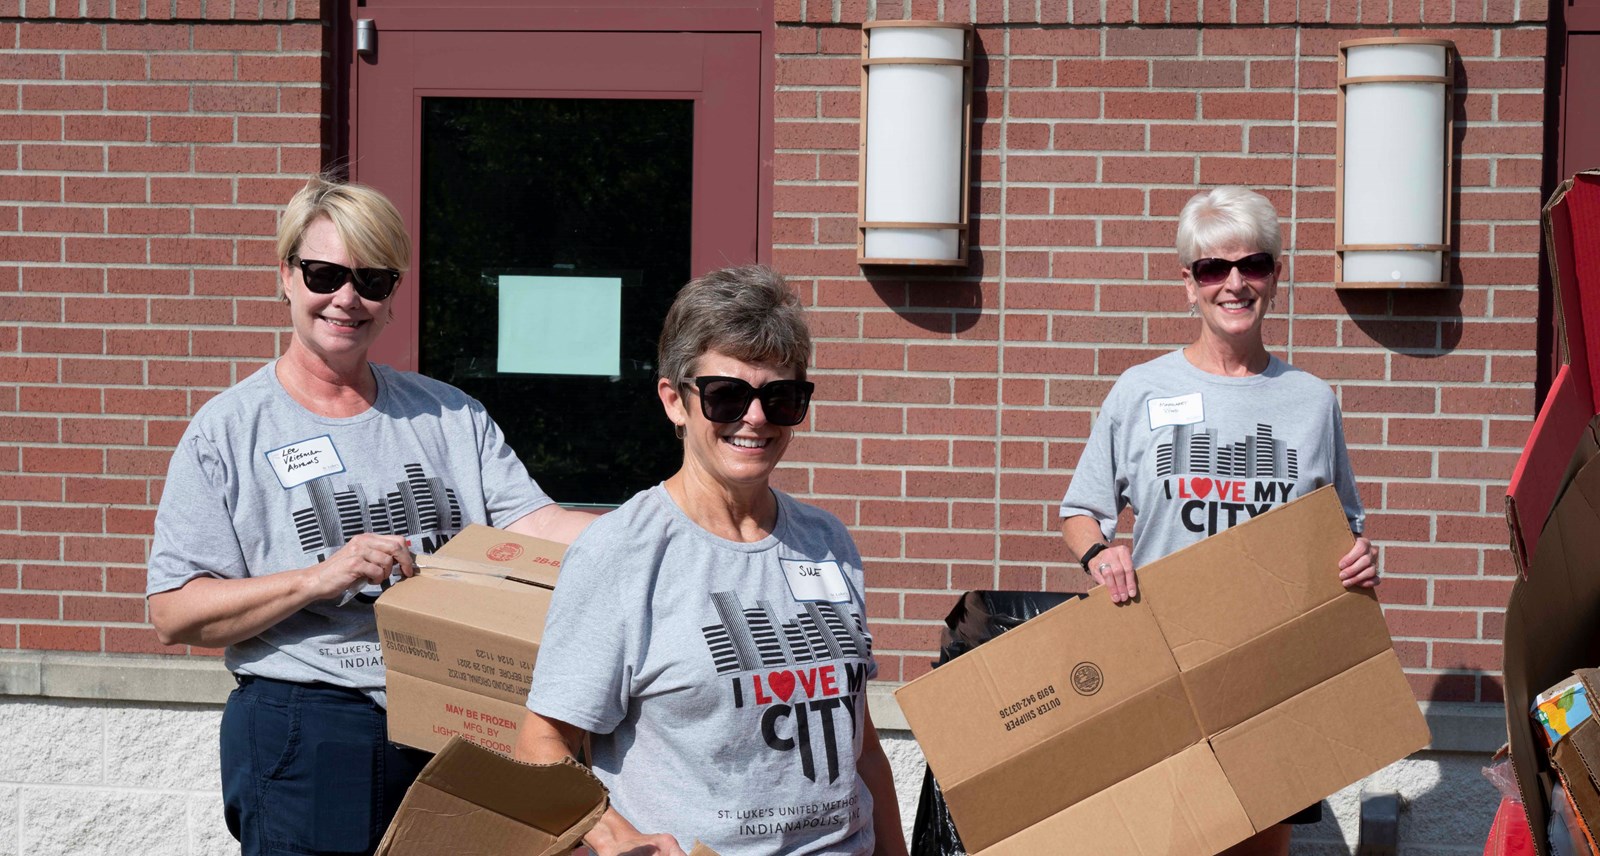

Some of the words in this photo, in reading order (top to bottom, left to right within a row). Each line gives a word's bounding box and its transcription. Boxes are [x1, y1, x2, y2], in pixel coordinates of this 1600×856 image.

[1164, 479, 1172, 500] I
[1254, 481, 1295, 503] MY
[799, 565, 822, 577] SUE
[318, 648, 332, 656] ST.
[336, 645, 371, 655] LUKE'S
[457, 658, 471, 669] 2021
[481, 664, 495, 676] AUG
[499, 668, 522, 682] BEFORE
[732, 677, 743, 708] I
[1036, 685, 1056, 700] B919
[999, 694, 1037, 718] 942-03736
[1036, 697, 1061, 715] OUTER
[445, 704, 463, 716] MAY
[466, 709, 479, 720] BE
[480, 713, 517, 730] FROZEN
[1004, 709, 1037, 731] SHIPPER
[463, 721, 485, 734] MFG.
[487, 727, 499, 738] BY
[480, 738, 511, 753] FOODS
[761, 694, 857, 785] CITY
[717, 810, 732, 819] ST.
[736, 807, 774, 819] LUKE'S
[778, 804, 818, 816] UNITED
[739, 814, 843, 835] INDIANAPOLIS,
